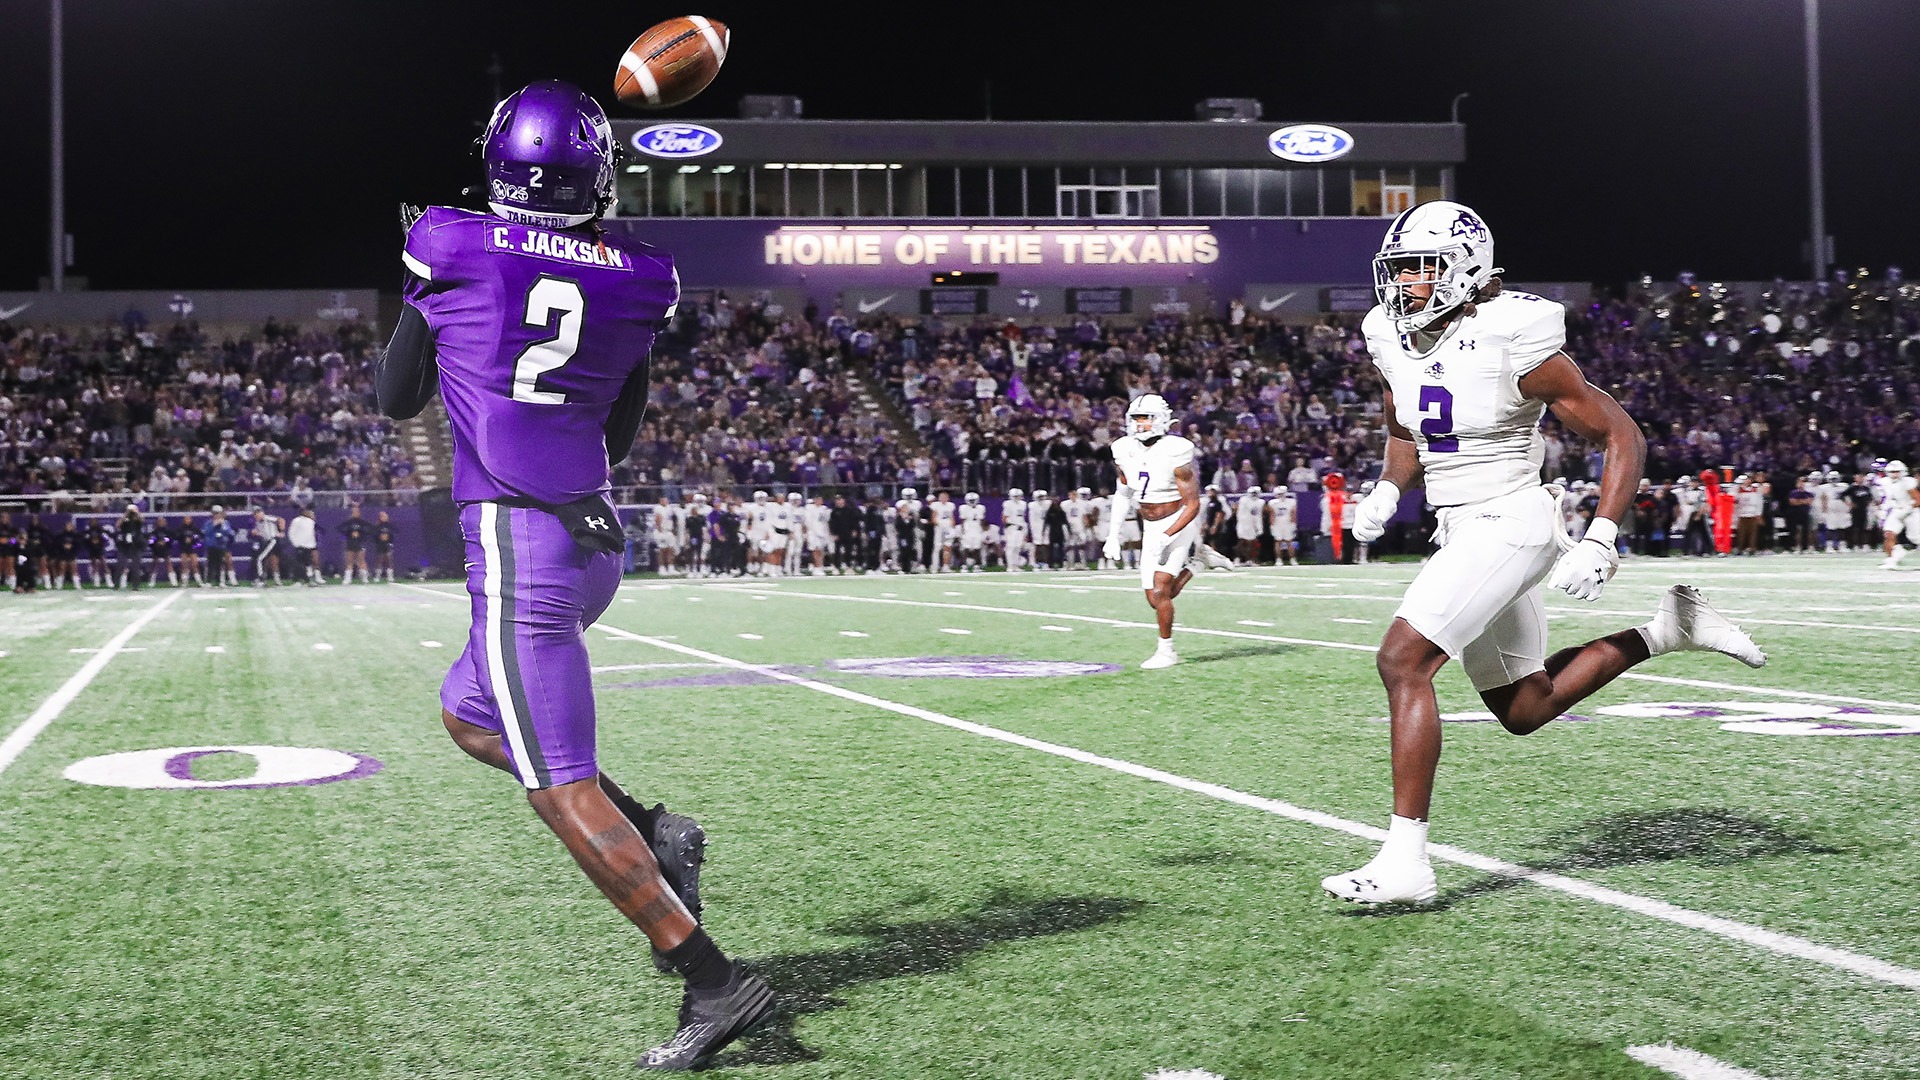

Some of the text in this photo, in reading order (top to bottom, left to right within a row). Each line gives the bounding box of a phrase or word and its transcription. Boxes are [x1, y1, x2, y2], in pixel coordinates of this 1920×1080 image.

[650, 129, 706, 152] Ford
[529, 166, 543, 188] 2
[506, 209, 568, 228] TARLETON
[493, 226, 624, 268] C. JACKSON
[764, 234, 1220, 265] HOME OF THE TEXANS
[512, 272, 587, 406] 2
[1418, 384, 1460, 452] 2
[1138, 471, 1150, 500] 7
